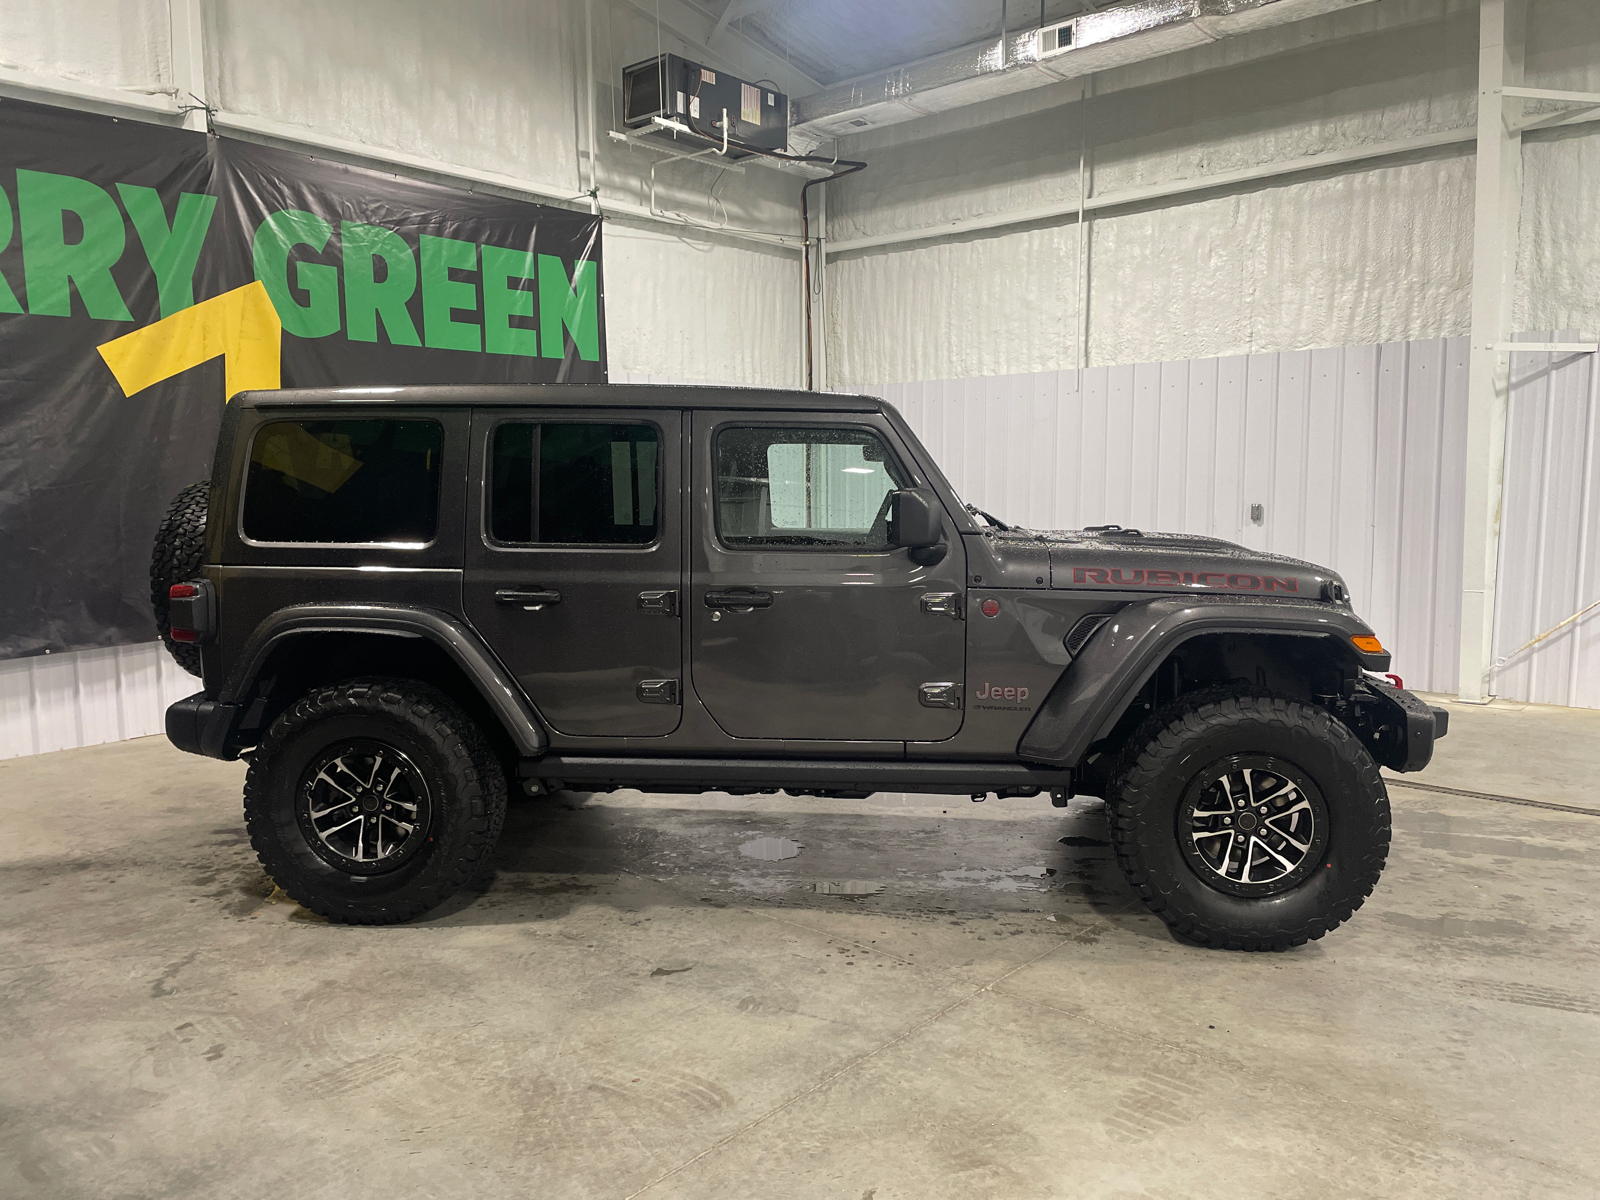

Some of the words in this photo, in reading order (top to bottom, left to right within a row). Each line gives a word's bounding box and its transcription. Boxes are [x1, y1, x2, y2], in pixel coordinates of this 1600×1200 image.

[0, 168, 217, 321] RY
[253, 209, 600, 361] GREEN
[1073, 567, 1298, 593] RUBICON
[975, 682, 1029, 703] Jeep
